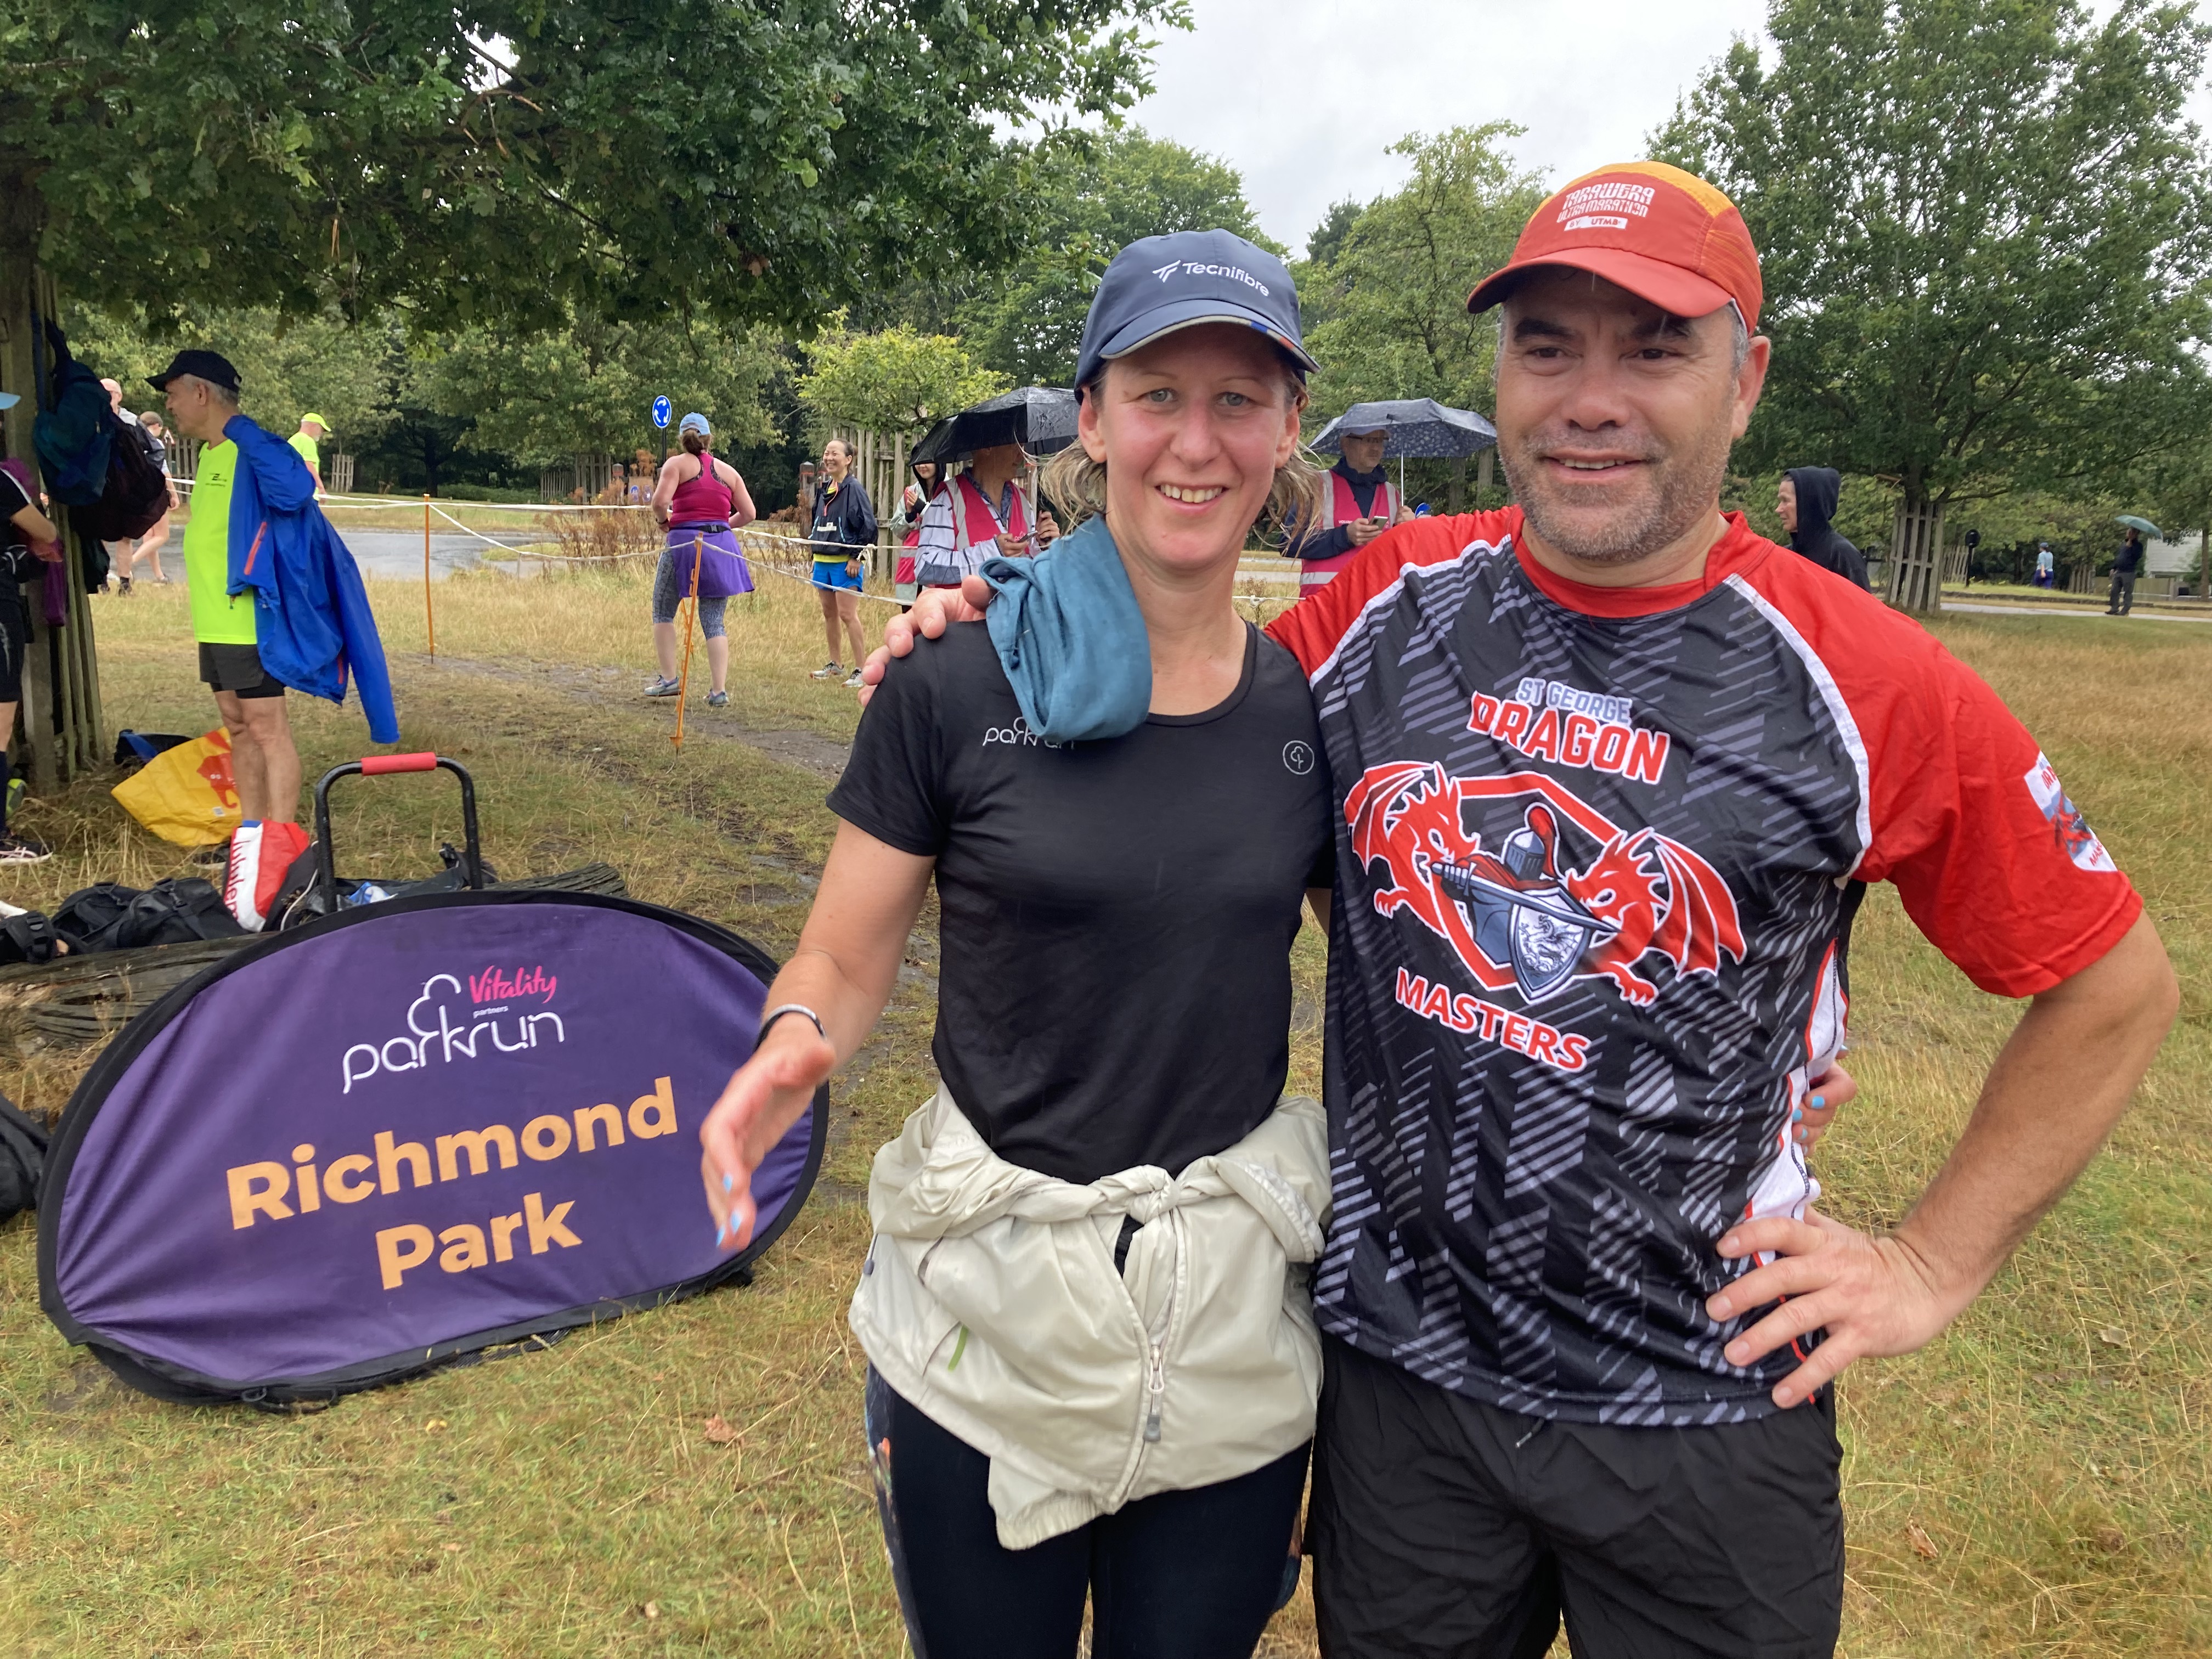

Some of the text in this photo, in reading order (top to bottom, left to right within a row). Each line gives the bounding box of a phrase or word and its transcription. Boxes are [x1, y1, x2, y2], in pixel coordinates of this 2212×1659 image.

[1556, 199, 1649, 223] ULTRAMARATHON
[1562, 183, 1655, 210] TARAWERA
[1182, 262, 1269, 297] Tecnifibre
[1516, 678, 1631, 722] ST GEORGE
[1468, 691, 1669, 785] DRAGON
[469, 965, 557, 1003] Vitality
[342, 973, 565, 1094] parkrun
[1396, 966, 1592, 1073] MASTERS
[227, 1076, 678, 1229] Richmond
[376, 1192, 583, 1290] Park
